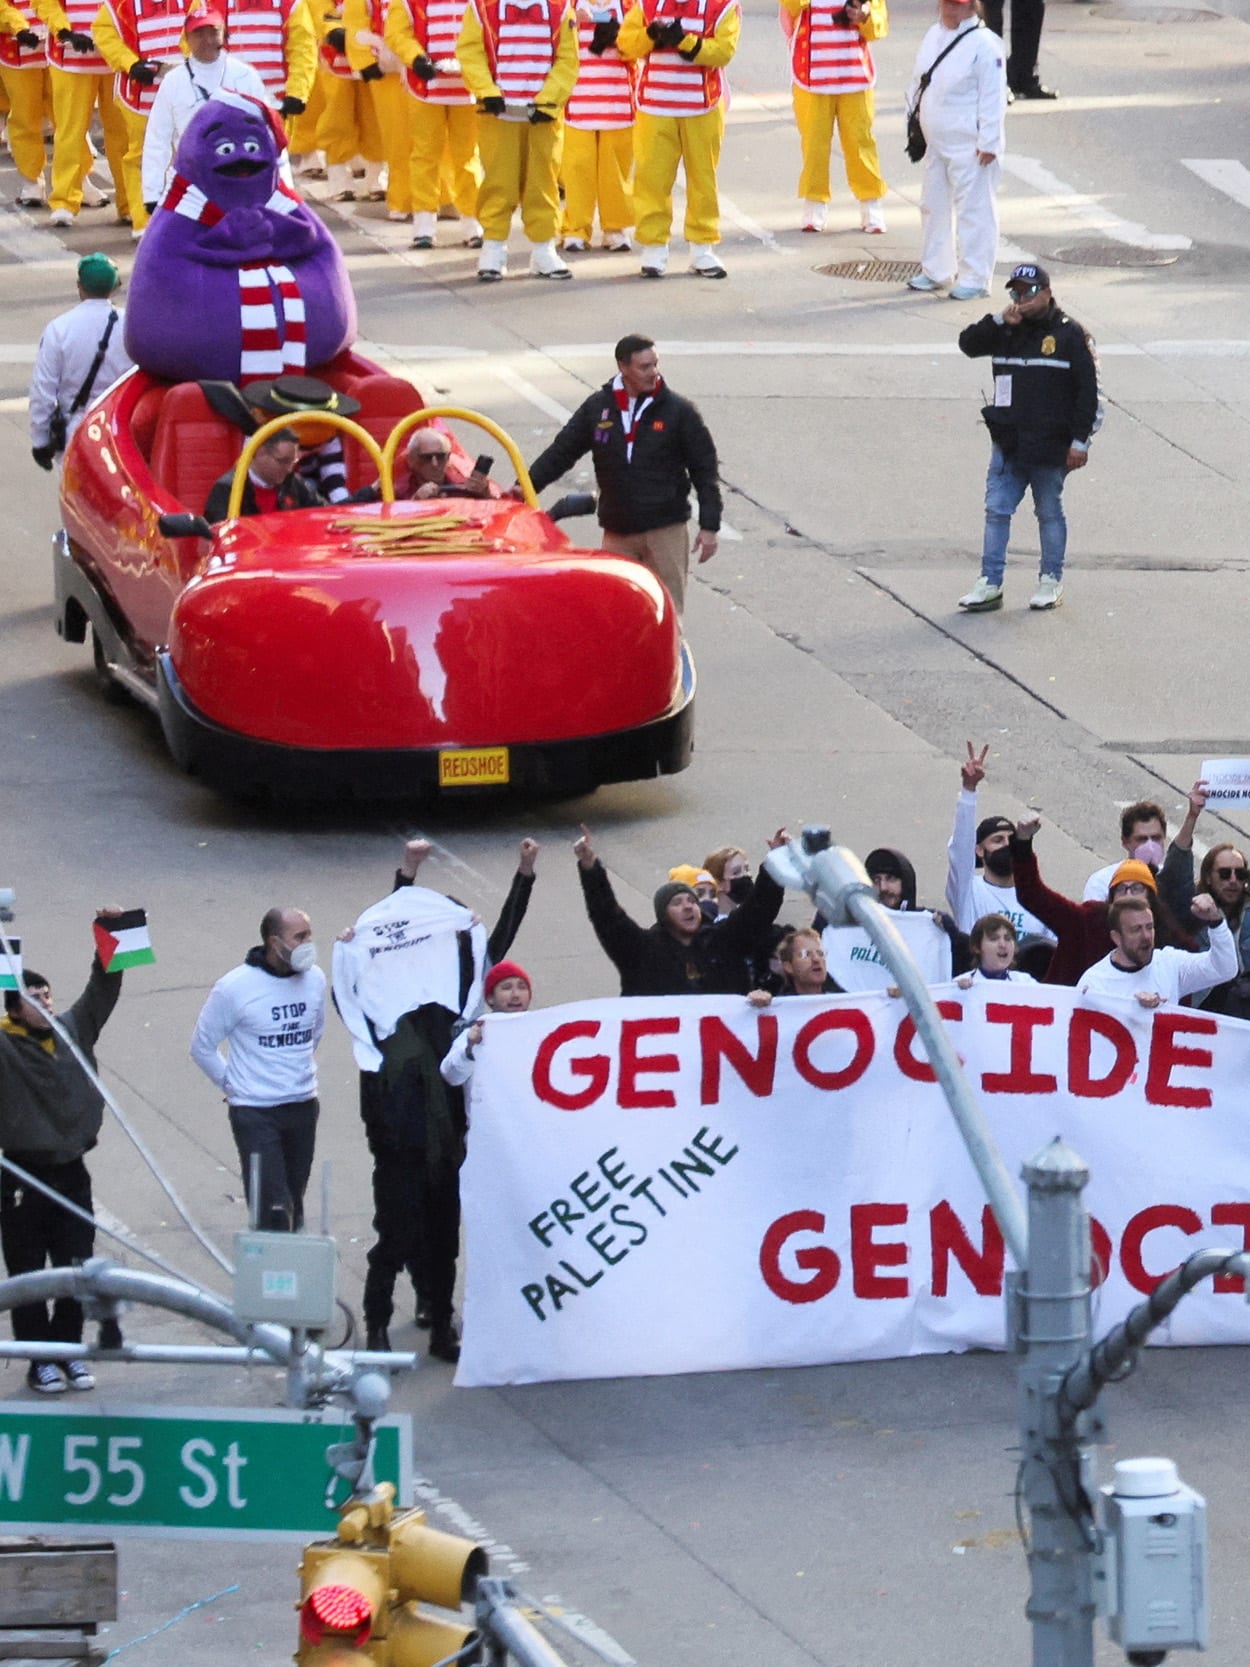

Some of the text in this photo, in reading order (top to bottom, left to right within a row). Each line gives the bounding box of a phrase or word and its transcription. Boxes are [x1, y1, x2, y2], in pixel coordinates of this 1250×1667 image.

[442, 756, 504, 777] REDSHOE
[271, 1002, 307, 1021] STOP
[258, 1029, 313, 1049] GENOCID
[529, 1146, 635, 1248] FREE
[521, 1126, 739, 1322] PALESTINE
[64, 1434, 145, 1506] 55
[179, 1438, 248, 1508] St
